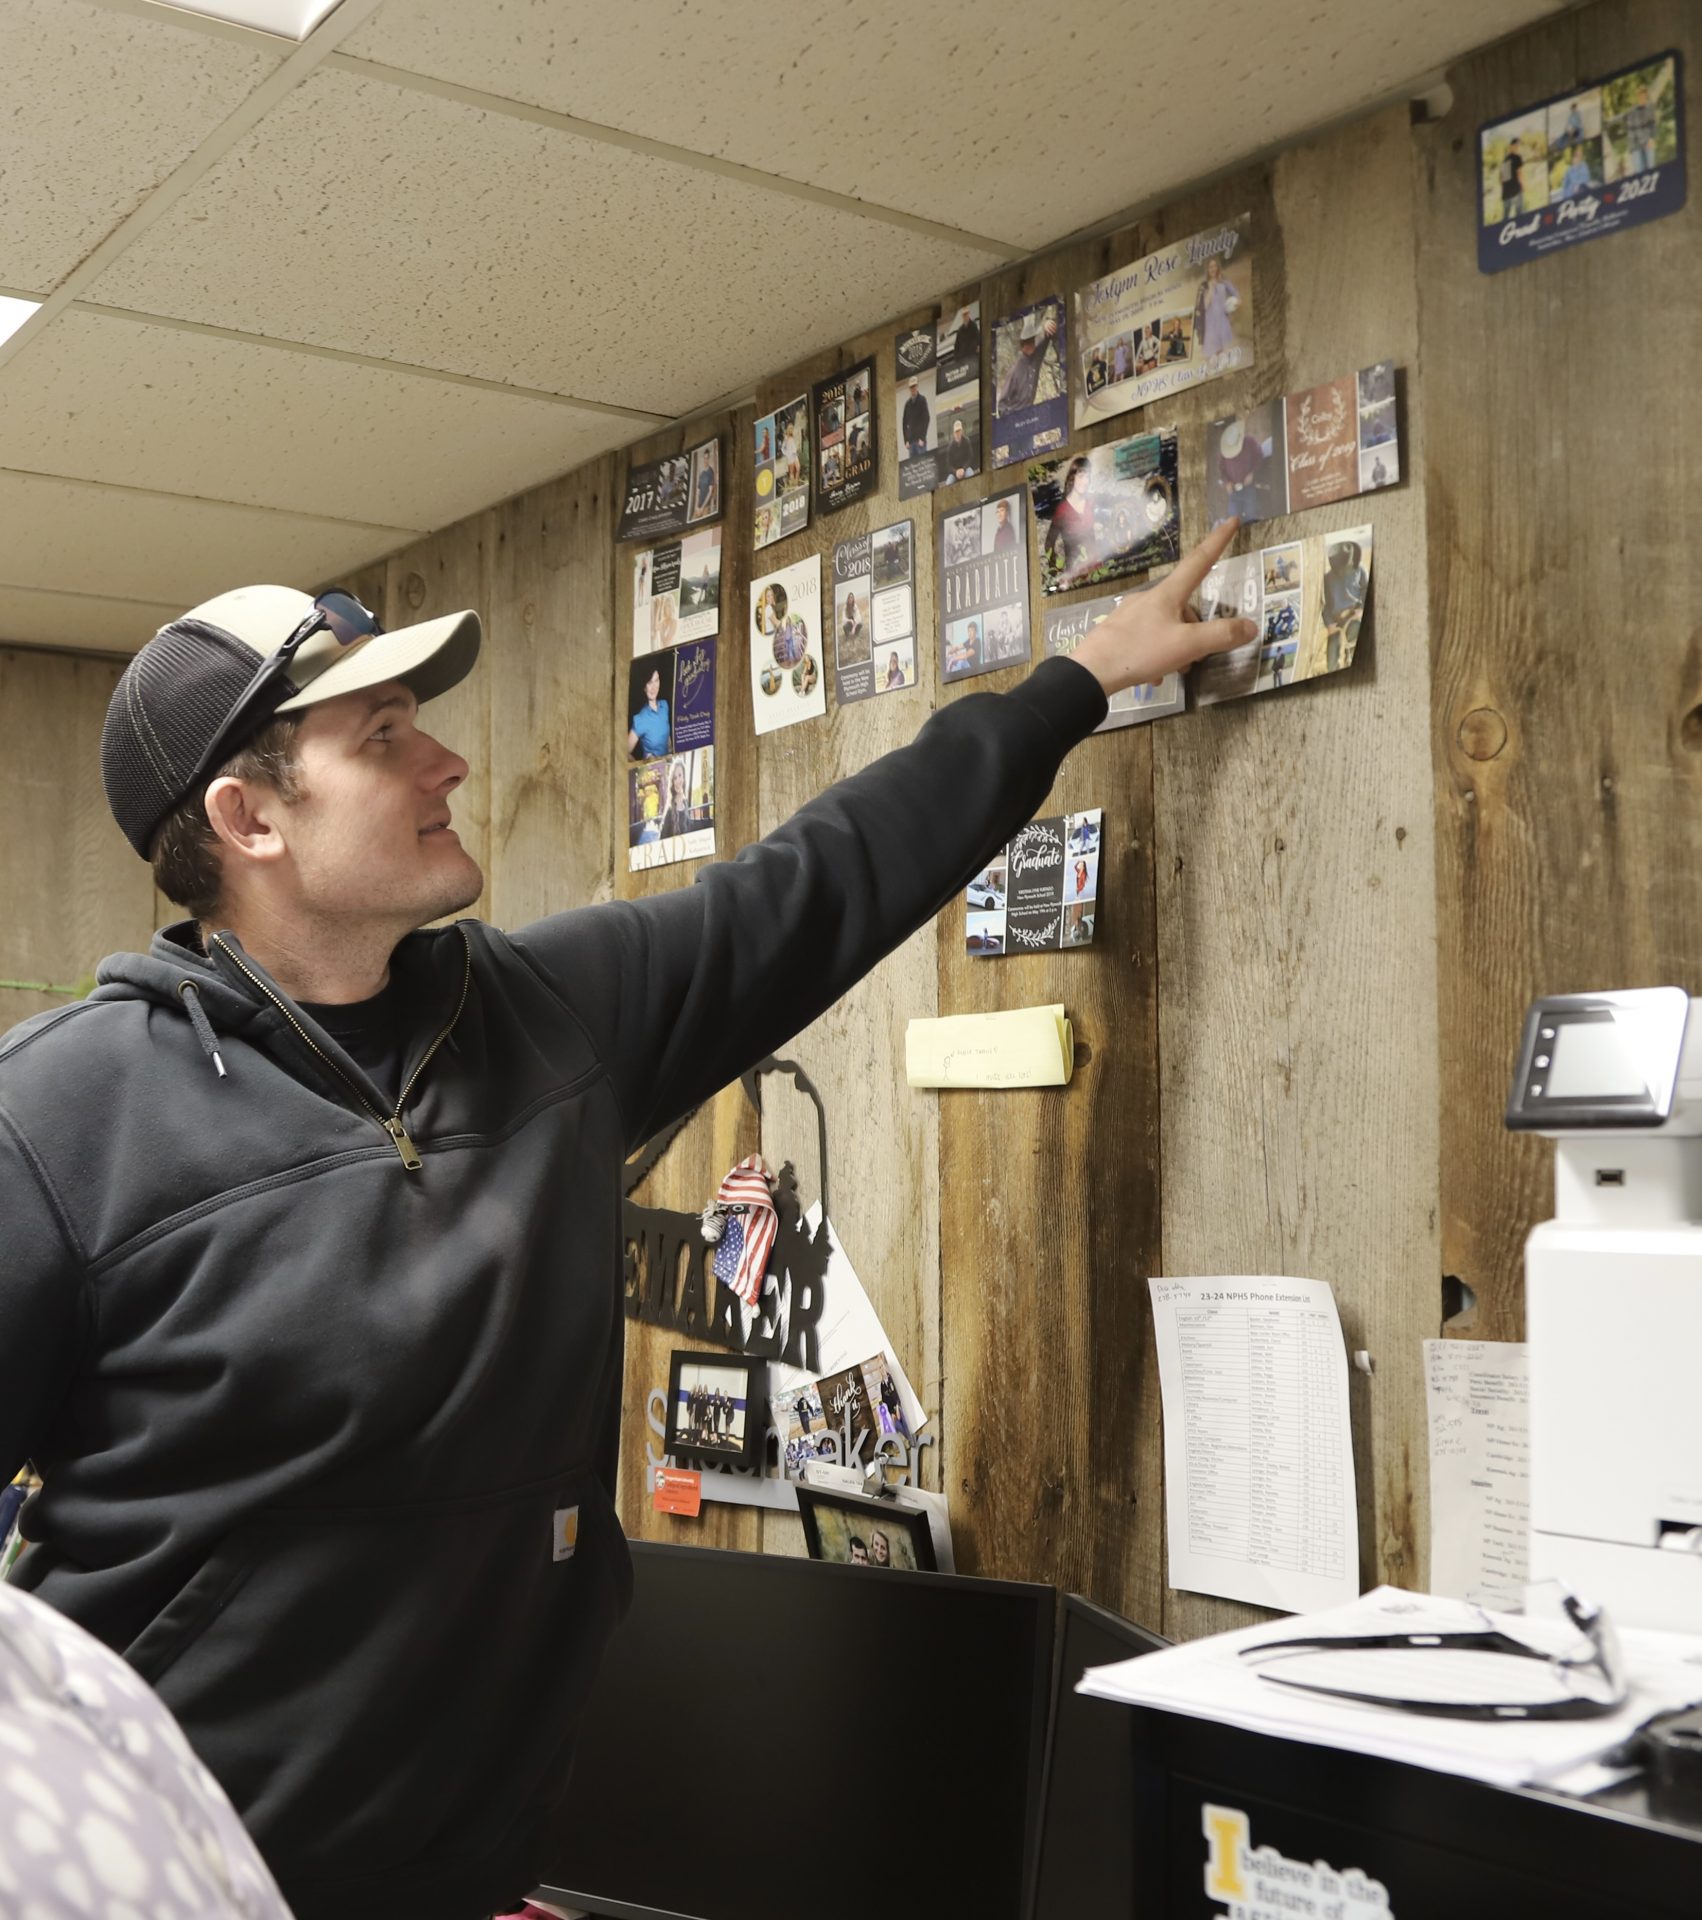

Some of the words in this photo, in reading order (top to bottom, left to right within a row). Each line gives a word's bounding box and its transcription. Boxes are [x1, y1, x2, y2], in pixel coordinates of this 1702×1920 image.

[1499, 213, 1541, 245] Grad
[1556, 195, 1601, 224] Party
[1617, 172, 1660, 204] 2021
[822, 384, 845, 402] 2018
[845, 459, 872, 480] GRAD
[625, 490, 655, 514] 2017
[782, 495, 806, 517] 2018
[847, 557, 872, 578] 2018
[791, 577, 817, 601] 2018
[946, 556, 1019, 613] GRADUATE
[1049, 620, 1076, 642] Class
[1011, 844, 1063, 878] Graduate
[1200, 1292, 1224, 1302] 23-24
[1226, 1292, 1249, 1302] NPHS
[1250, 1292, 1274, 1302] Phone
[1275, 1293, 1302, 1303] Extension
[829, 1371, 862, 1414] thank
[1210, 1815, 1245, 1896] I
[1243, 1850, 1313, 1885] believe
[1320, 1872, 1340, 1895] in
[1346, 1876, 1381, 1903] the
[1256, 1879, 1316, 1913] future
[1322, 1899, 1345, 1920] of
